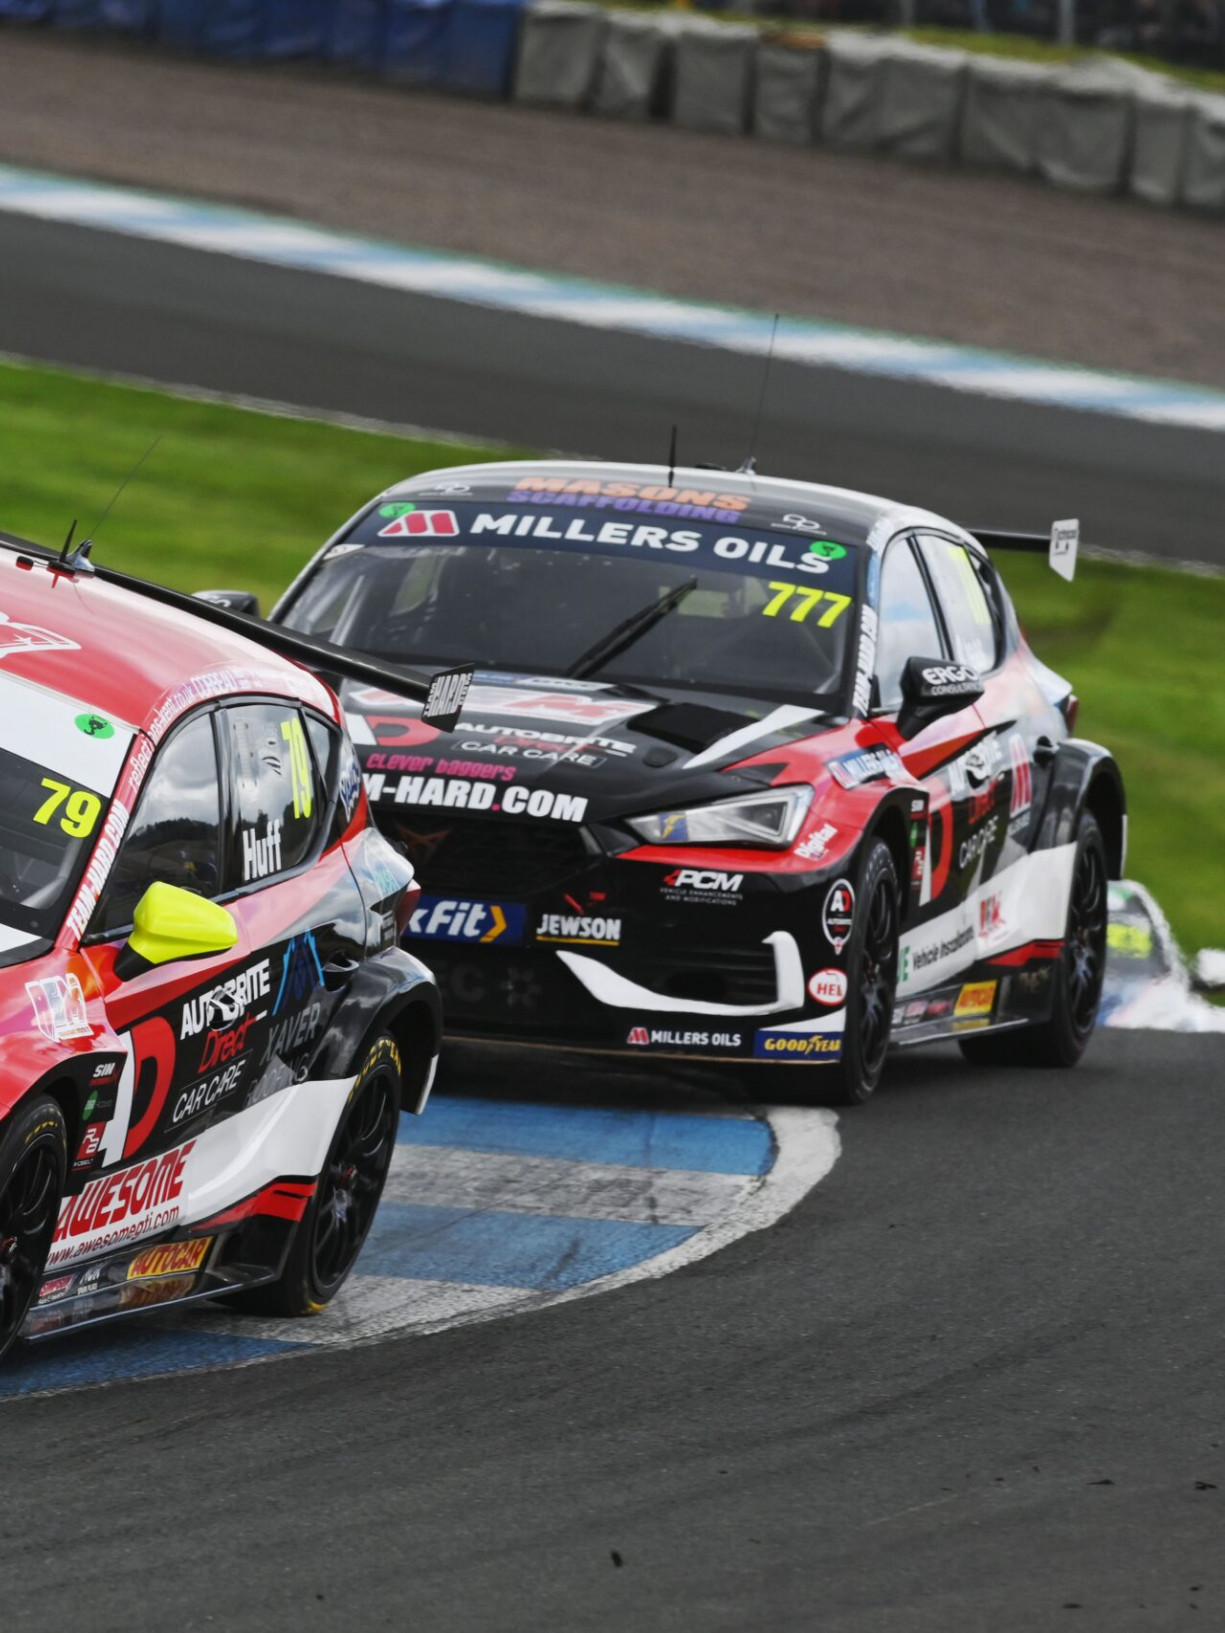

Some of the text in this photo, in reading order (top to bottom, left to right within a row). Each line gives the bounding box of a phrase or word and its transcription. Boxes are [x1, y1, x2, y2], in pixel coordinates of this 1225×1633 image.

[507, 489, 741, 523] SCAFFOLDING
[515, 476, 751, 511] MASONS
[470, 513, 831, 574] MILLERS OILS
[762, 582, 851, 628] 777
[455, 722, 637, 754] AUTOBRITE
[461, 741, 599, 766] CAR CARE
[33, 777, 102, 838] 79
[242, 818, 282, 881] Huff
[674, 869, 744, 892] PCM
[536, 913, 622, 940] JEWSON
[259, 1002, 321, 1067] XAVER
[651, 1030, 741, 1047] MILLERS OILS
[172, 1059, 247, 1124] CAR CARE
[52, 1139, 198, 1243] AWESOME
[130, 1238, 209, 1278] AUTOCAR
